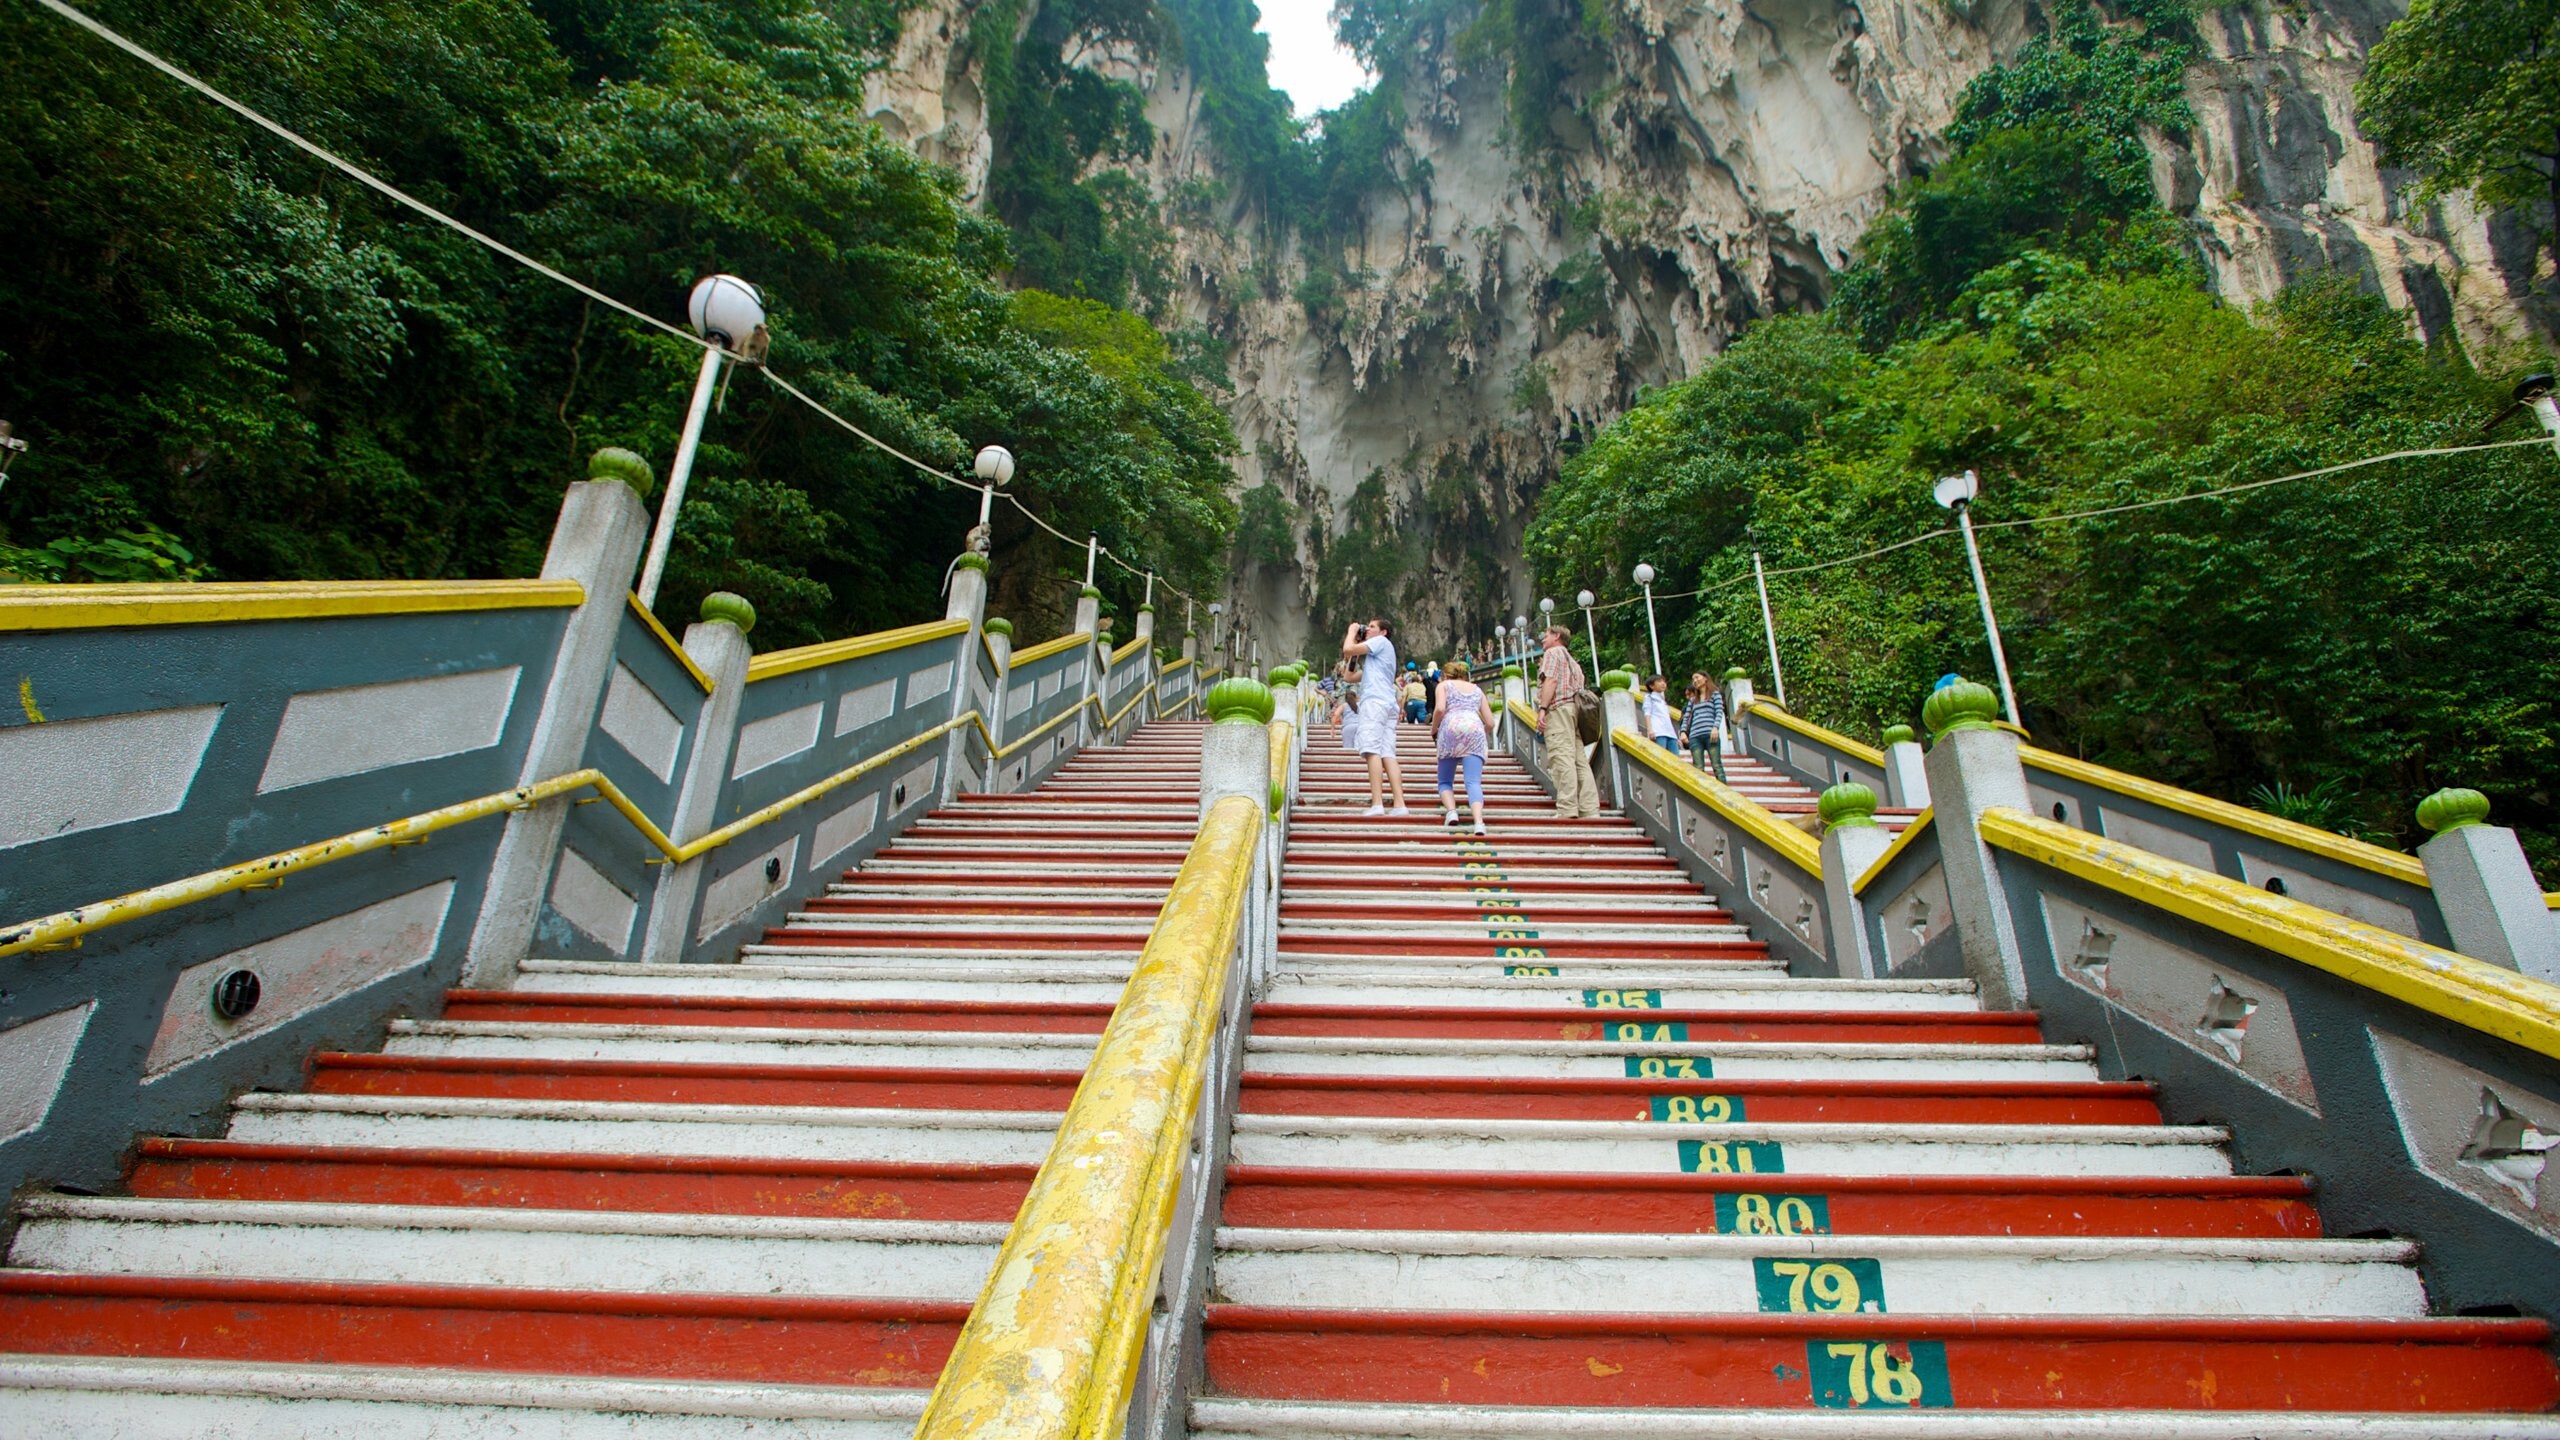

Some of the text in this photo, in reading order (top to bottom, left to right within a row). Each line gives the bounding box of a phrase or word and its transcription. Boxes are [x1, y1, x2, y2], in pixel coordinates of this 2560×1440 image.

[1596, 990, 1650, 1009] 85
[1618, 1023, 1672, 1042] 84
[1640, 1057, 1700, 1078] 83
[1667, 1095, 1732, 1122] 82
[1696, 1143, 1754, 1173] 81
[1736, 1194, 1815, 1235] 80
[1773, 1262, 1861, 1313] 79
[1827, 1343, 1923, 1405] 78
